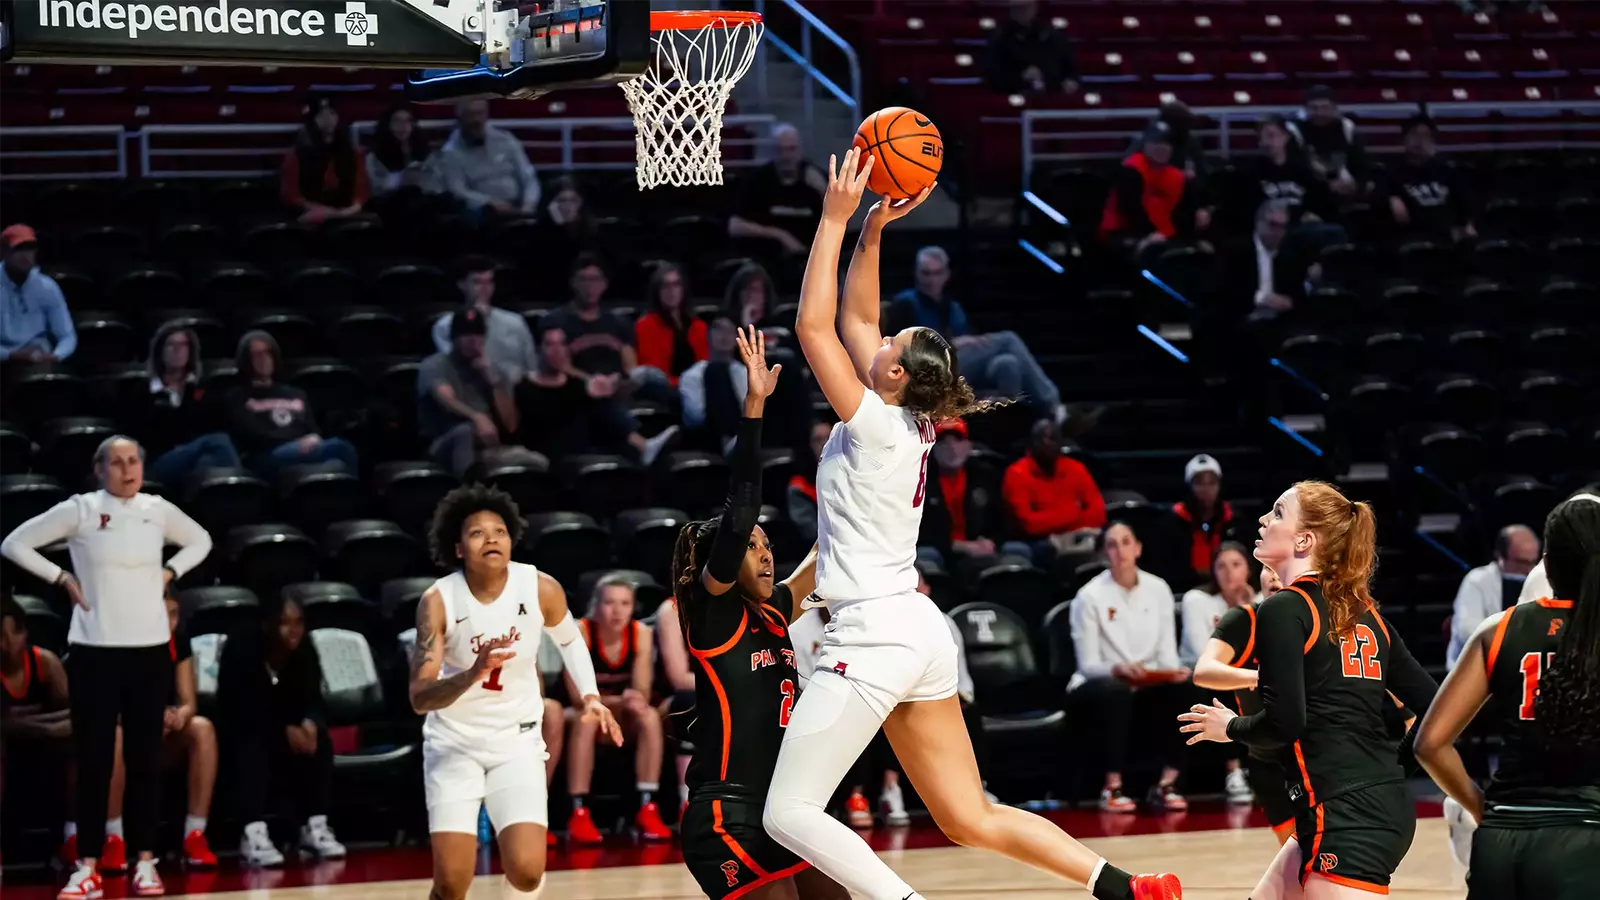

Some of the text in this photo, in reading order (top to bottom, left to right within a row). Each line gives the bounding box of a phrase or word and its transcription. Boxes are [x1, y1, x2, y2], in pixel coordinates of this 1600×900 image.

[38, 0, 325, 39] Independence
[967, 609, 997, 643] T
[1340, 623, 1382, 681] 22
[481, 666, 503, 691] 1
[720, 860, 739, 888] P
